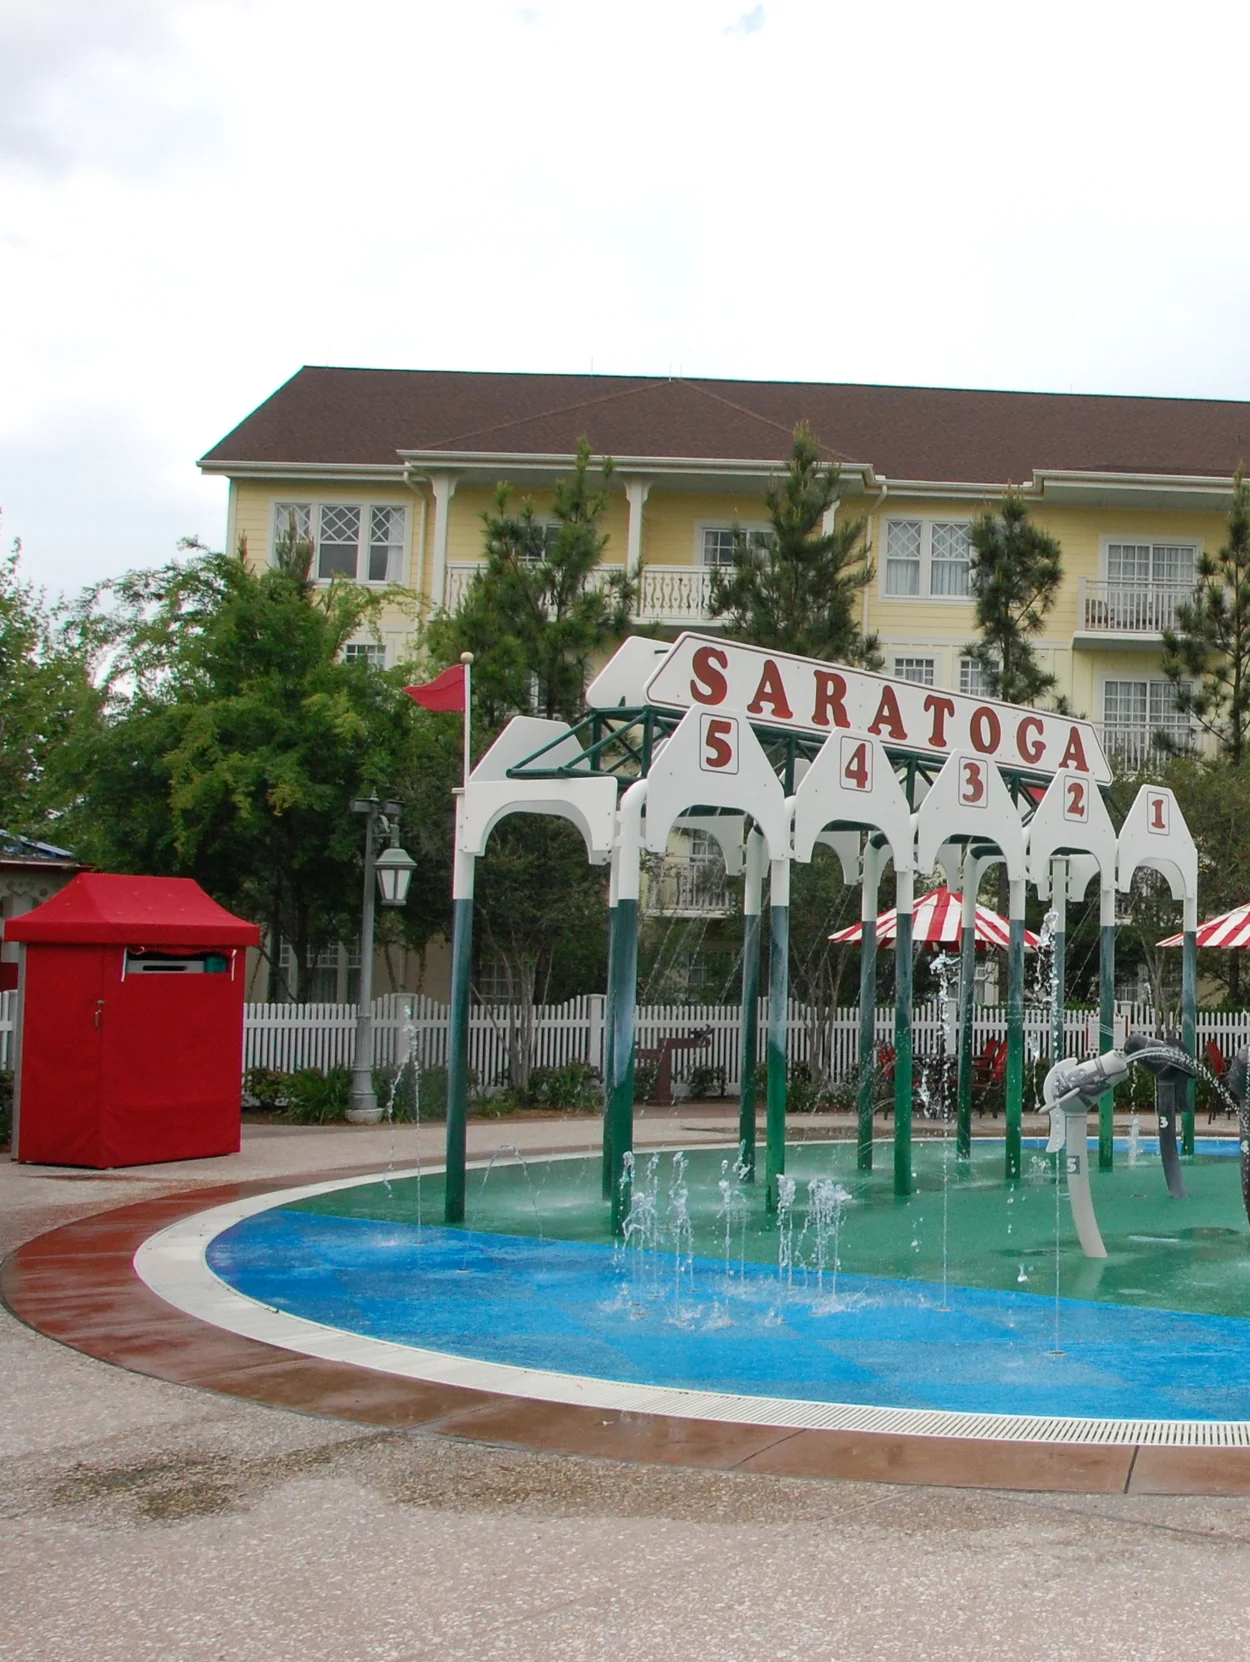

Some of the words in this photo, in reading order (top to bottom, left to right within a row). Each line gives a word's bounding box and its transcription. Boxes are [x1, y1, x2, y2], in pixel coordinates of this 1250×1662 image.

[690, 646, 1090, 773] SARATOGA
[706, 720, 732, 768] 5
[845, 743, 868, 789] 4
[962, 762, 984, 803] 3
[1067, 782, 1085, 817] 2
[1151, 799, 1166, 829] 1
[1159, 1116, 1169, 1128] 3
[1067, 1157, 1077, 1172] 5
